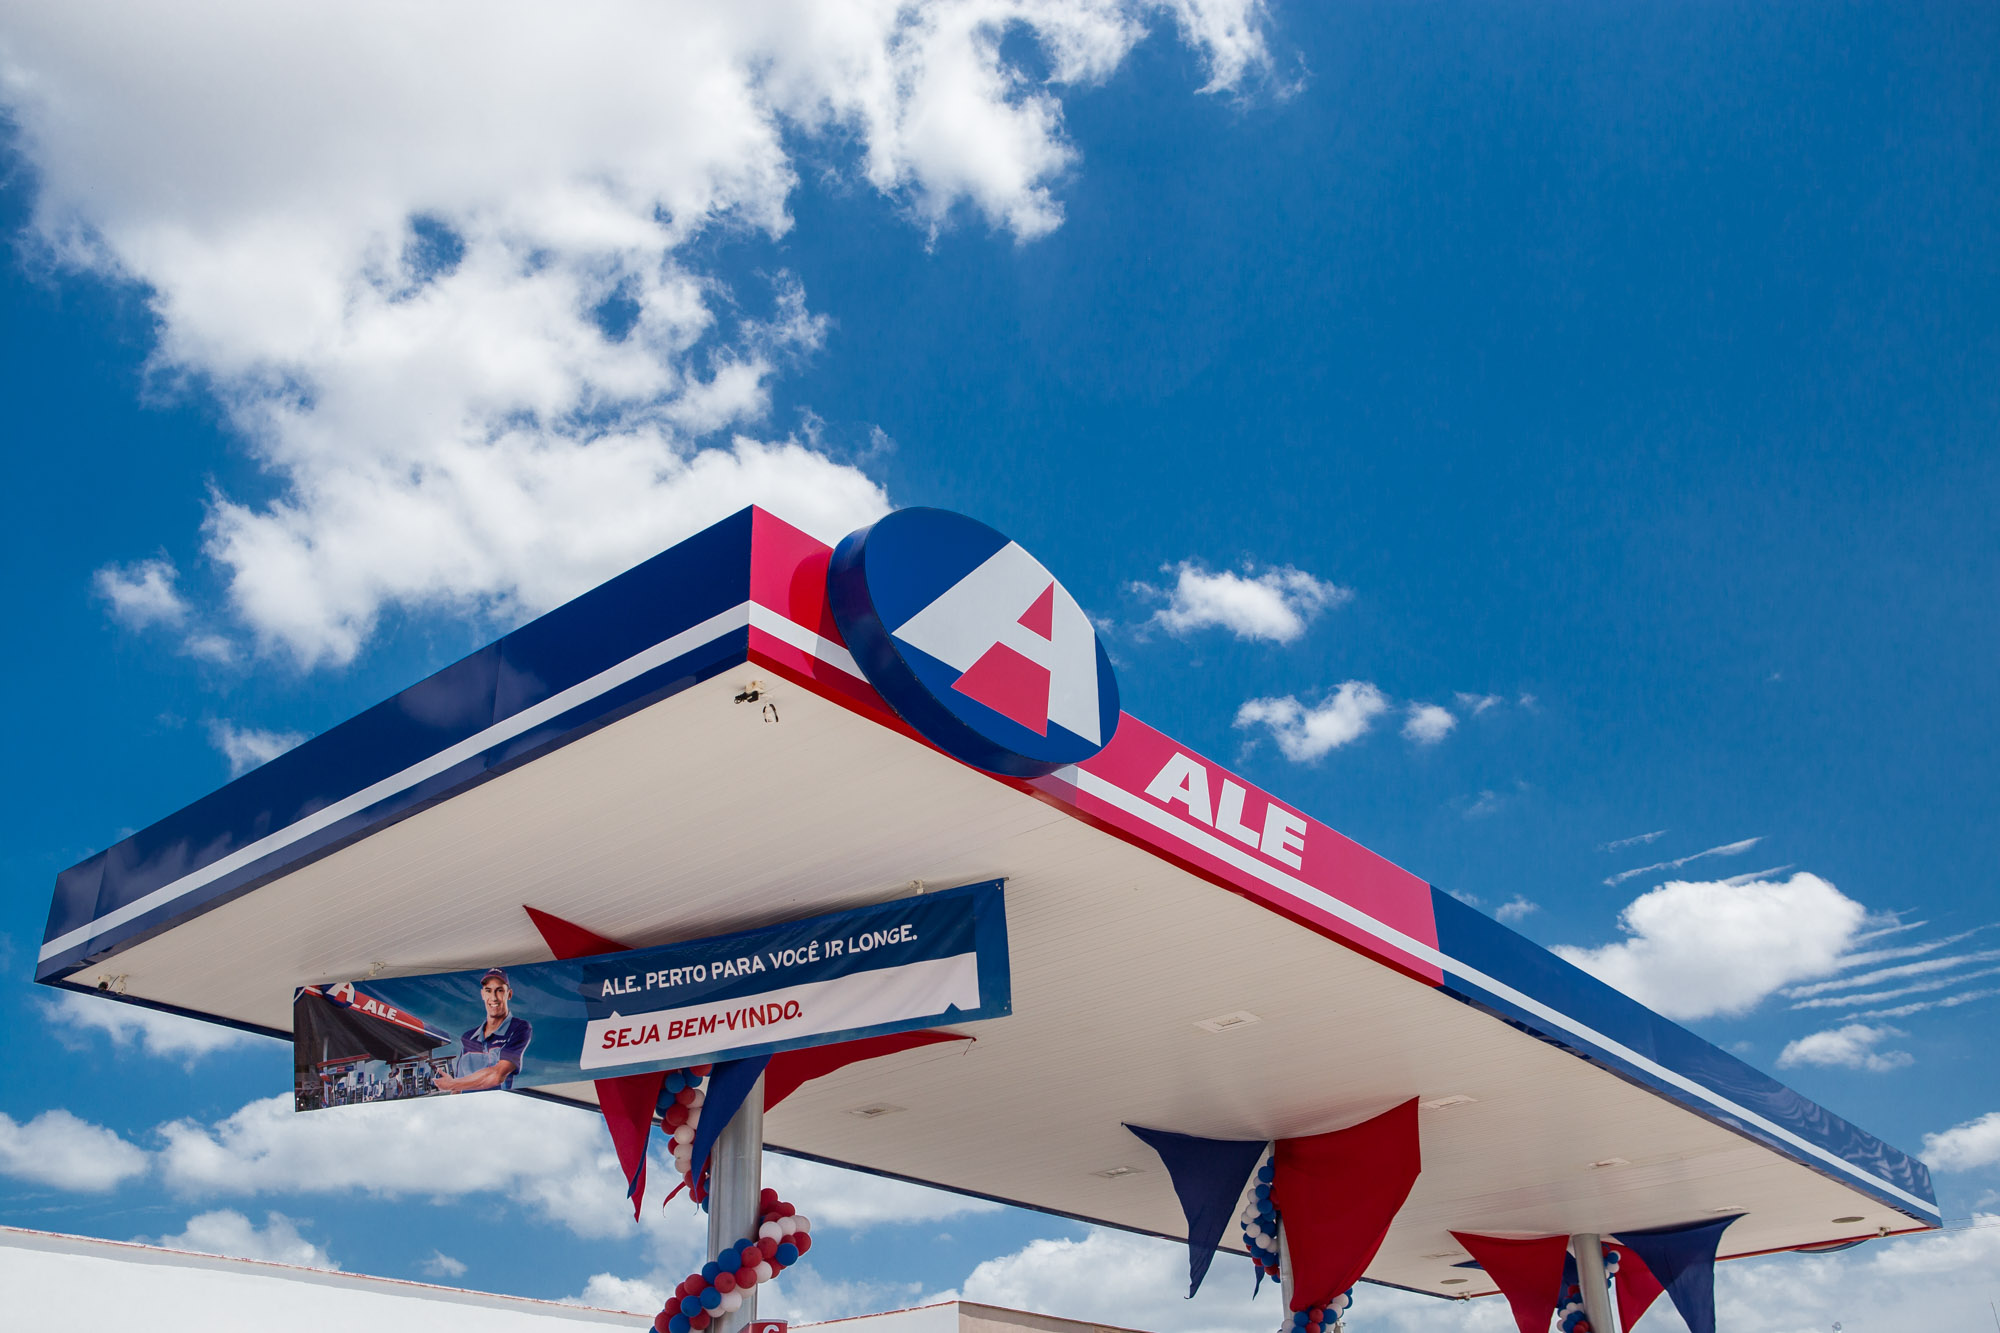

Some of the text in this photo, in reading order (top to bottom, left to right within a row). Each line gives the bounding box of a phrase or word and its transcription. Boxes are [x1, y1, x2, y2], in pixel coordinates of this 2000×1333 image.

[891, 540, 1101, 747] A
[1143, 751, 1307, 871] ALE
[601, 924, 918, 997] ALE. PERTO PARA VOCÊ IR LONGE.
[362, 999, 398, 1021] ALE
[601, 999, 803, 1050] SEJA BEM-VINDO.
